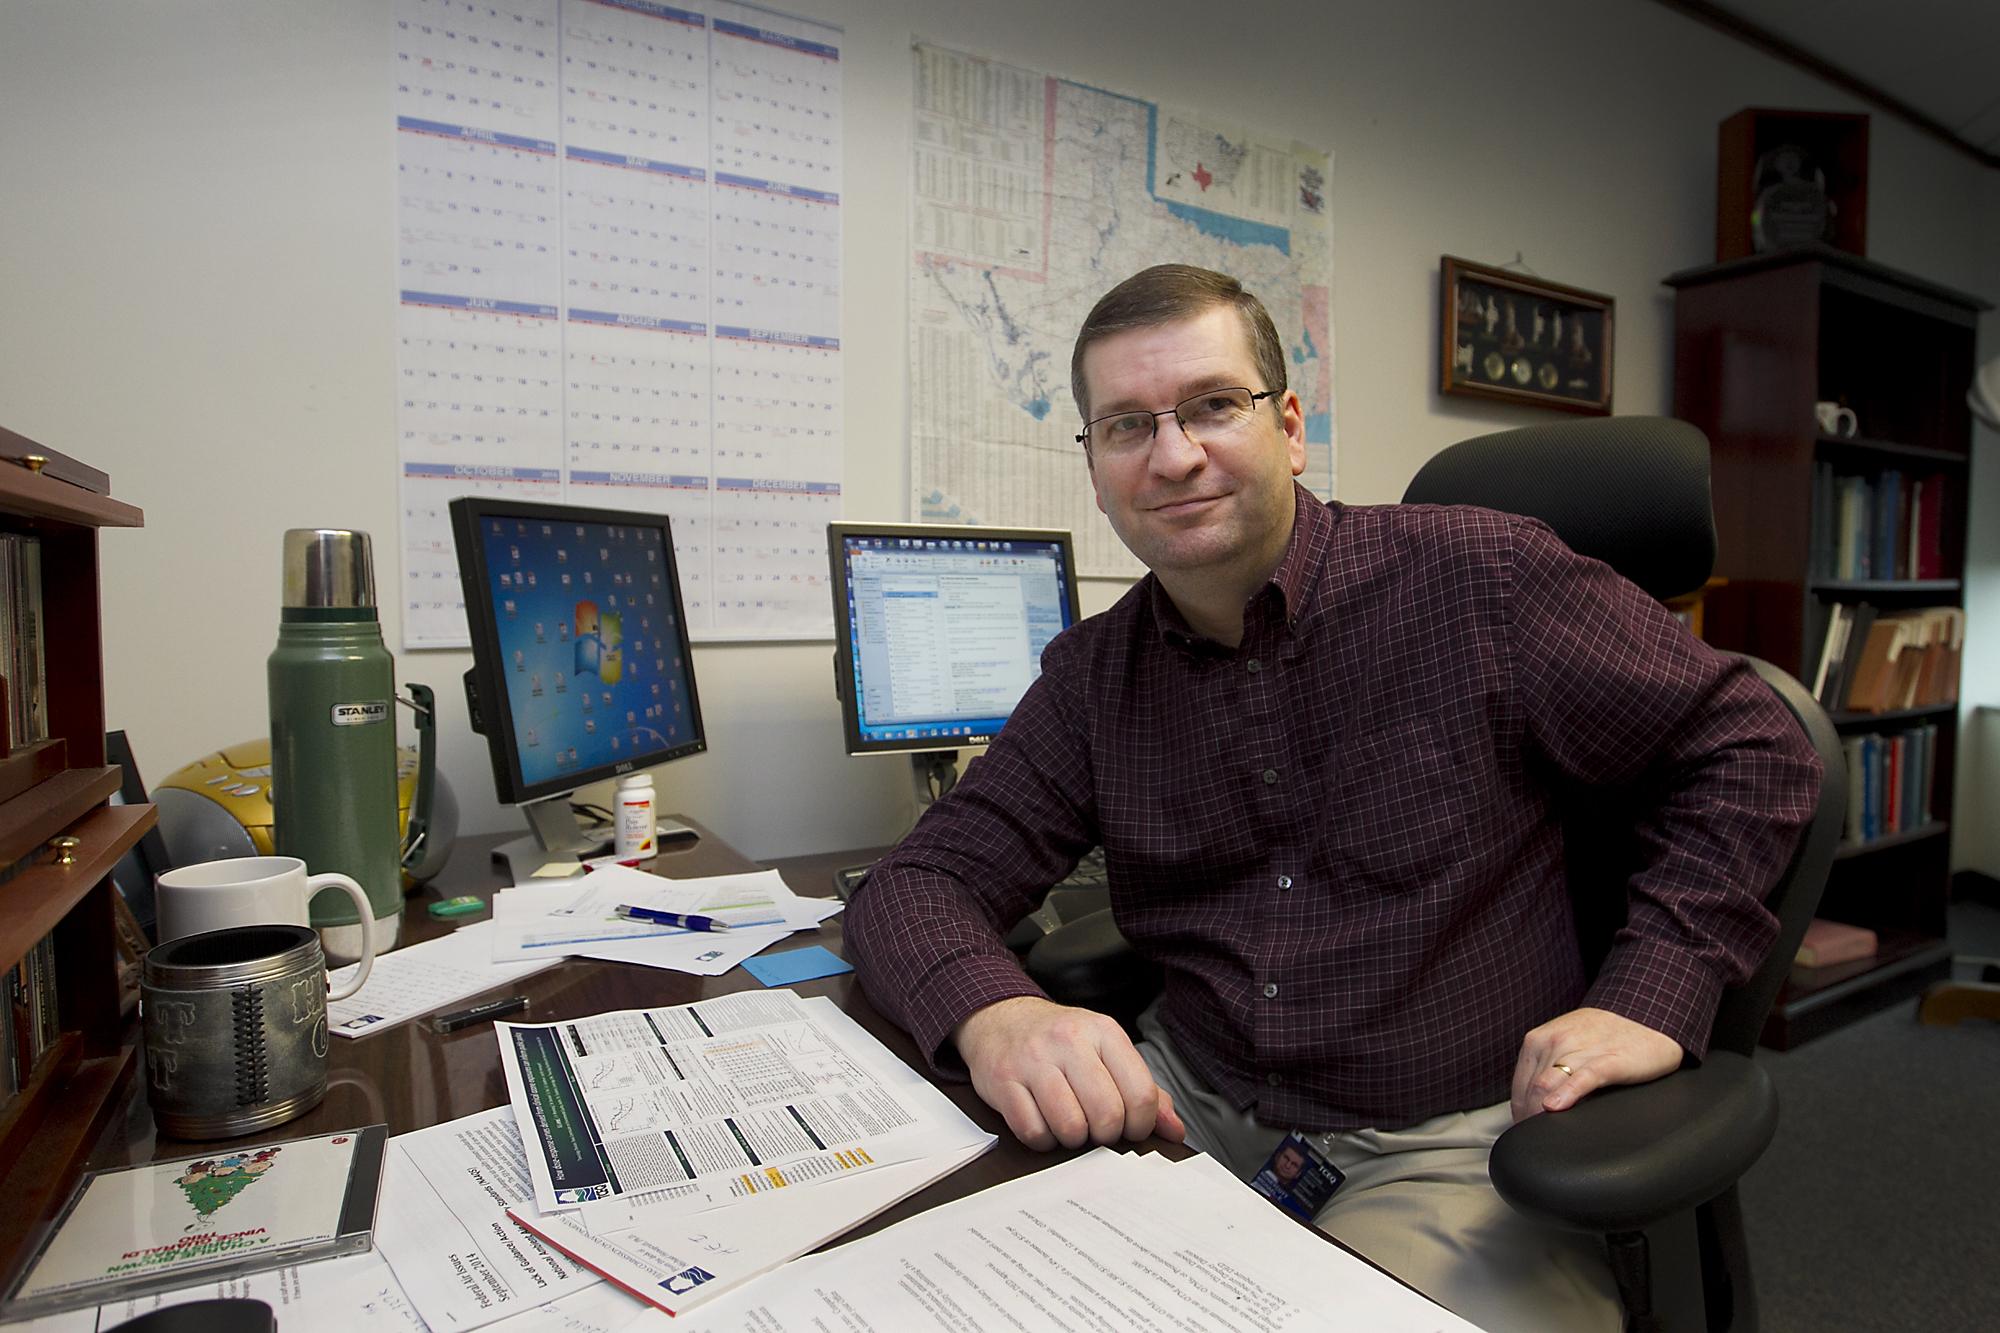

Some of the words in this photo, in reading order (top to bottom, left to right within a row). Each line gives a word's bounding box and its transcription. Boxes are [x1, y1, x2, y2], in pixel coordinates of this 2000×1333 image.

[466, 297, 497, 309] JULY
[616, 314, 661, 328] AUGUST
[750, 328, 808, 344] SEPTEMBER
[454, 466, 514, 477] OCTOBER
[610, 472, 671, 484] NOVEMBER
[752, 480, 806, 490] DECEMBER
[338, 706, 386, 716] STANLEY
[969, 736, 990, 744] DELL
[547, 1140, 562, 1169] dose-response
[555, 1169, 565, 1180] How
[1317, 1166, 1338, 1185] TCEQ
[484, 1184, 507, 1208] Standards
[177, 1231, 215, 1241] TRIO
[216, 1227, 266, 1241] VINCE
[121, 1236, 210, 1260] GUARALDI
[491, 1222, 528, 1267] Guidance/Action
[523, 1234, 547, 1257] Ambient
[107, 1254, 174, 1273] BROWN
[446, 1252, 467, 1276] Issues
[465, 1251, 484, 1270] 2014
[543, 1255, 567, 1280] National
[459, 1272, 474, 1286] Air
[478, 1267, 511, 1302] September
[530, 1273, 547, 1288] Lack
[466, 1283, 491, 1308] Federal
